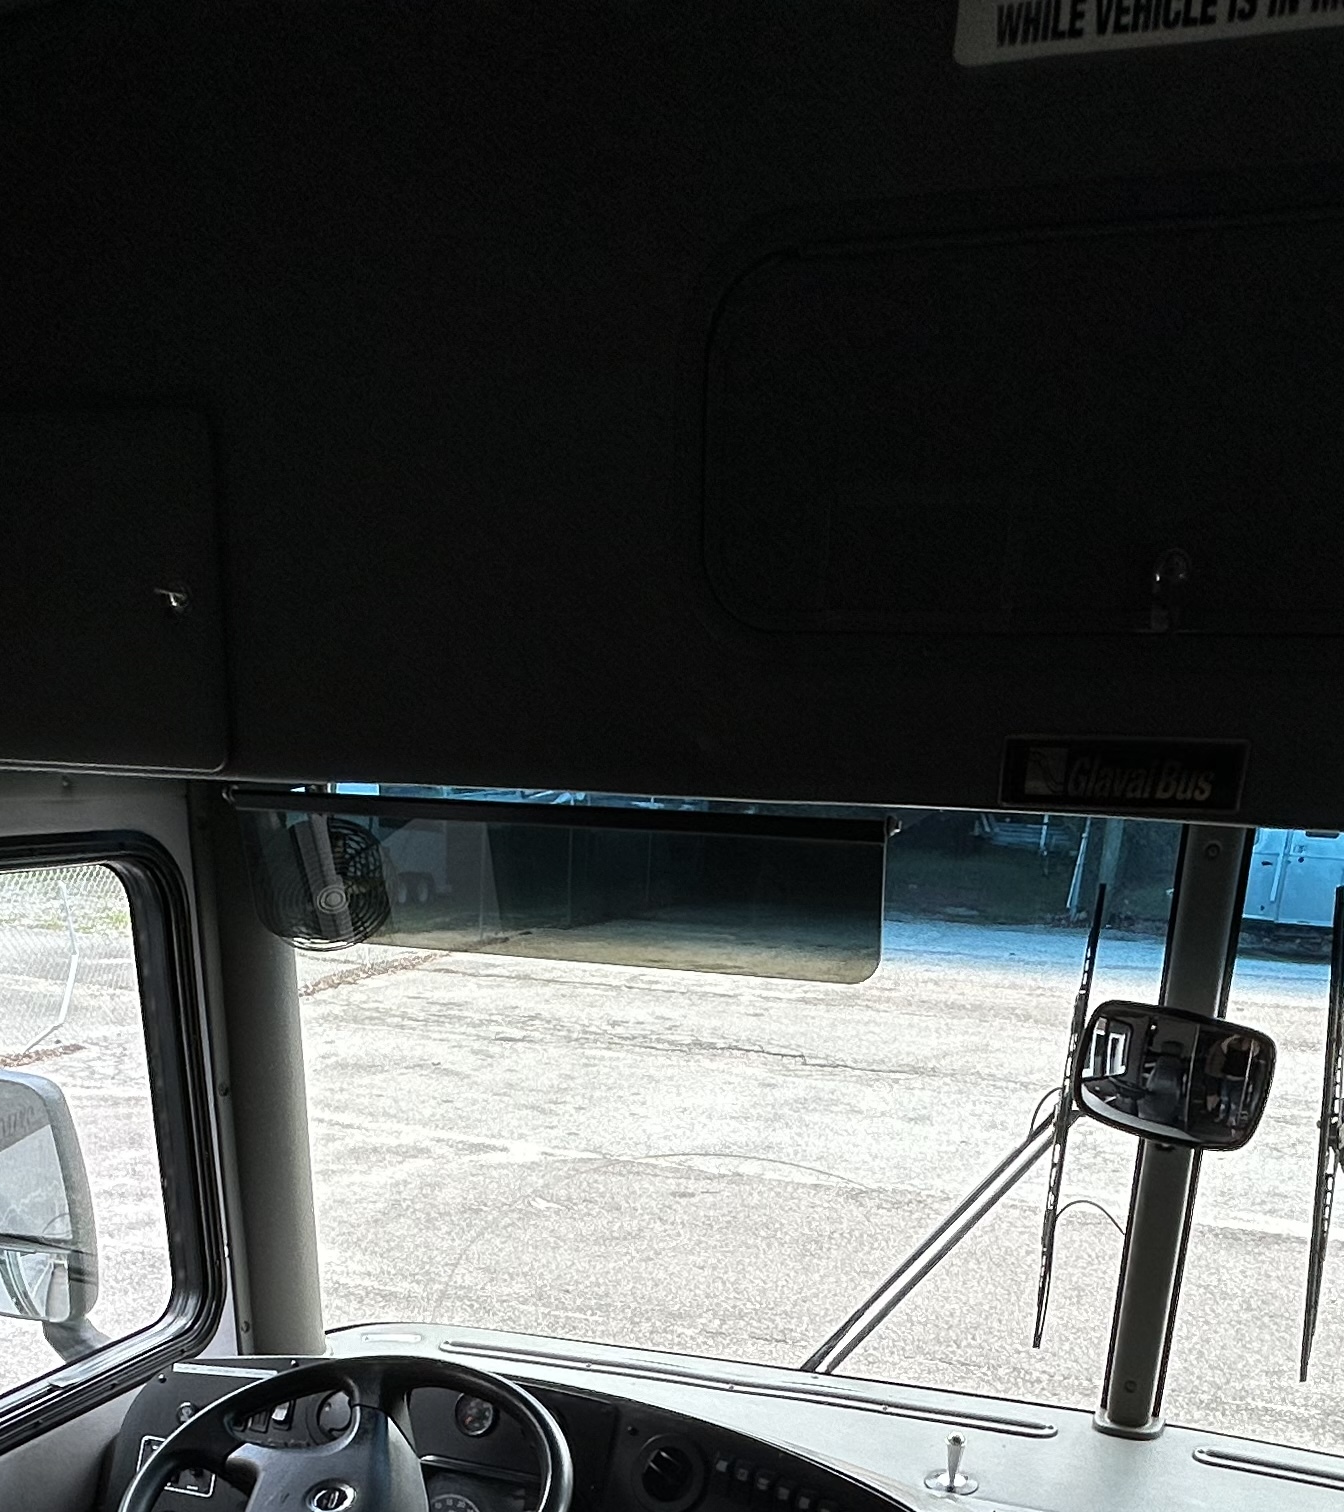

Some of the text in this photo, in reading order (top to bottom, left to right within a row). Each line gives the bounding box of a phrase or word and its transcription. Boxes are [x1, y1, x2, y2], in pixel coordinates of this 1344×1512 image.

[996, 0, 1085, 47] WHILE
[1096, 0, 1217, 36] VEHICLE
[1066, 754, 1216, 803] Glaval Bus
